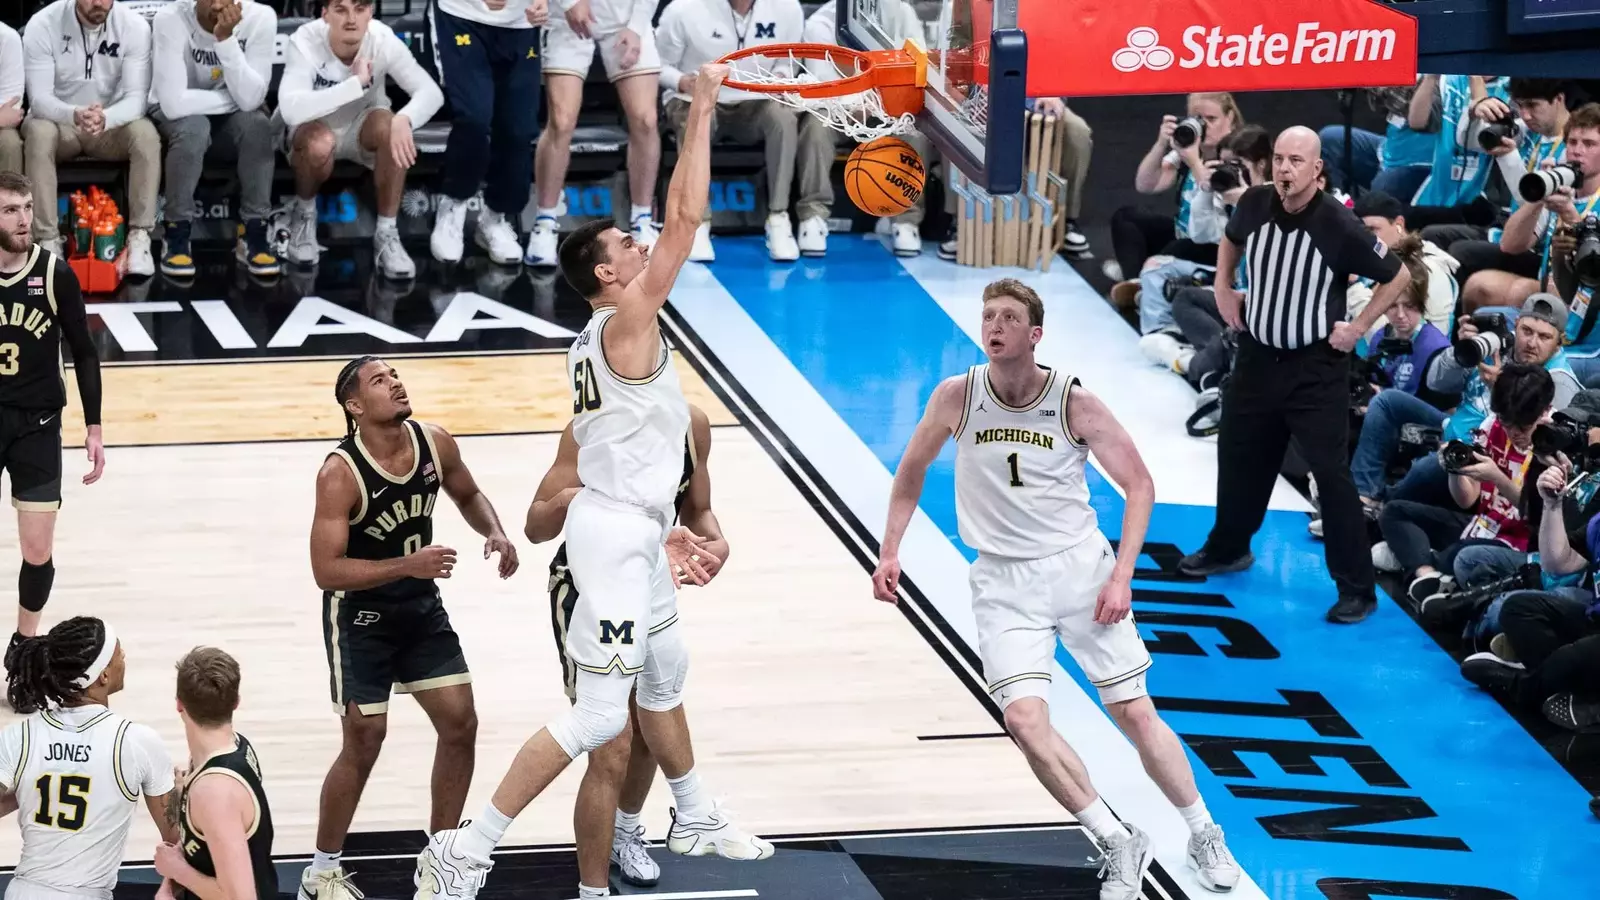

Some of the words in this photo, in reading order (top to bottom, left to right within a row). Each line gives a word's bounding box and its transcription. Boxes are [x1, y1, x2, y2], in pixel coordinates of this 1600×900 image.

[455, 33, 472, 46] M
[754, 22, 776, 39] M
[98, 40, 120, 58] M
[85, 291, 579, 352] TIAA
[573, 357, 602, 415] 50
[974, 428, 1054, 450] MICHIGAN
[1007, 452, 1025, 487] 1
[363, 493, 436, 541] PURDU
[353, 610, 381, 626] P
[600, 619, 635, 645] M
[44, 742, 92, 763] JONES
[1152, 688, 1474, 852] TEN
[34, 773, 92, 832] 15
